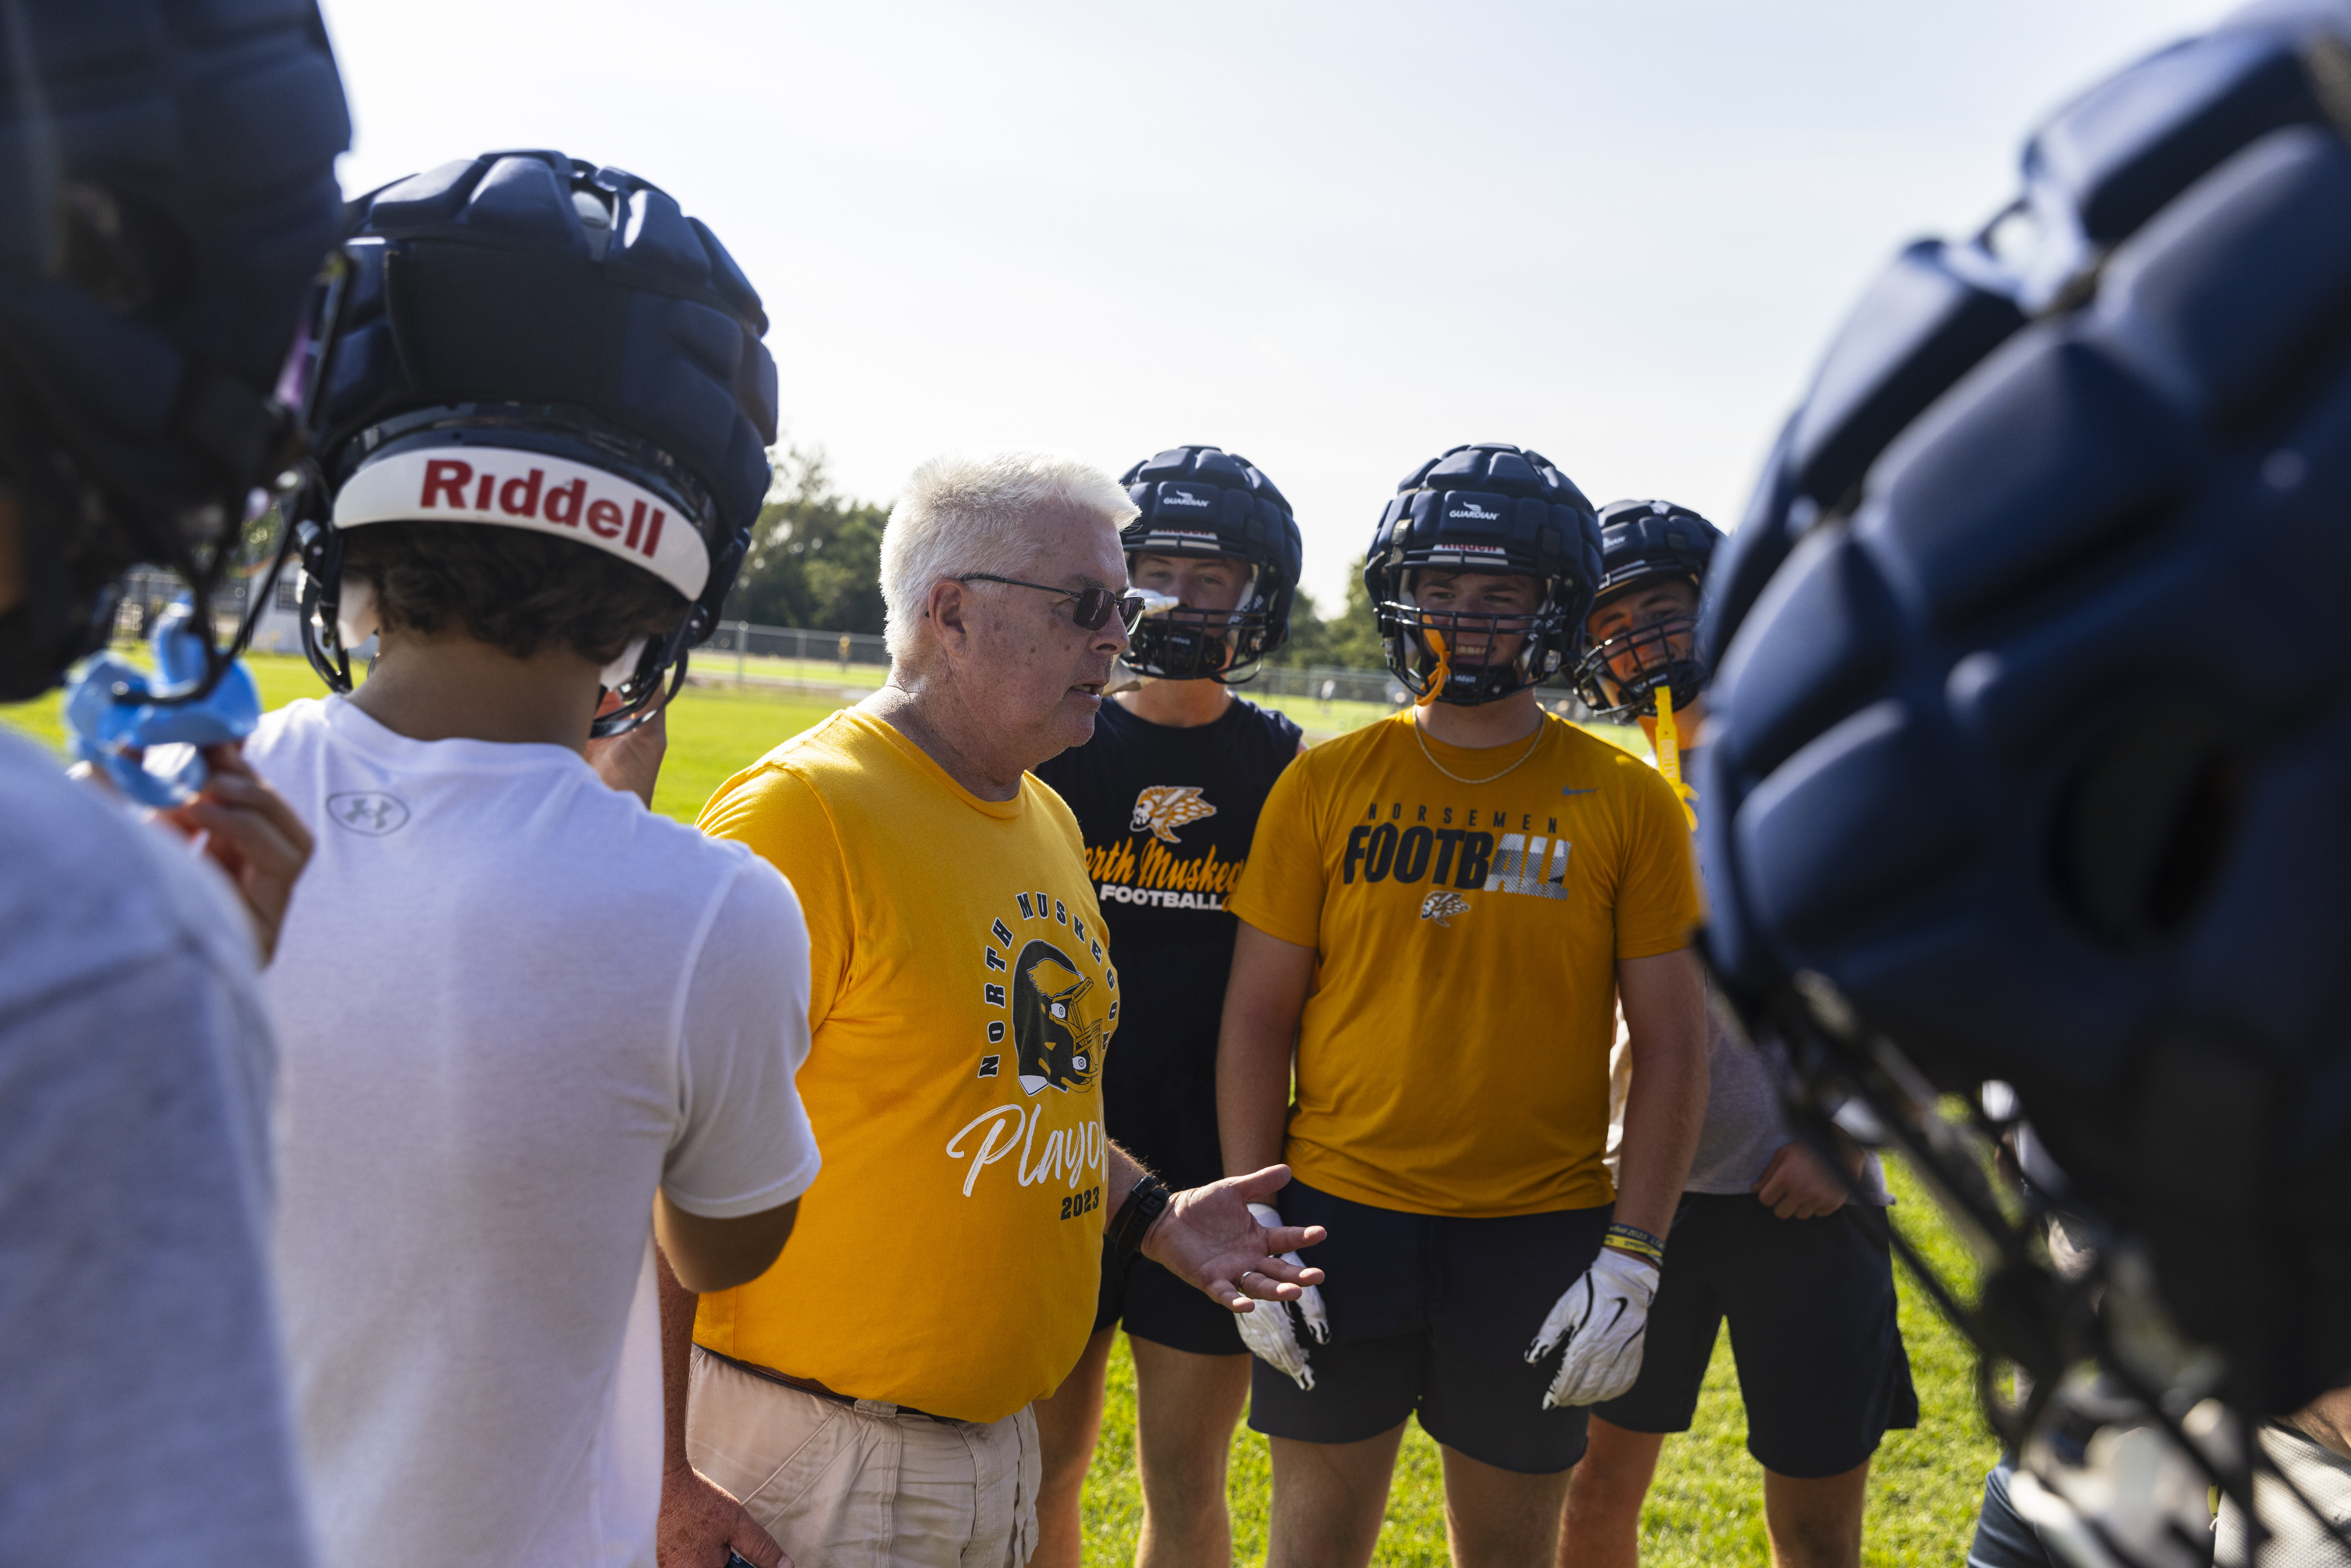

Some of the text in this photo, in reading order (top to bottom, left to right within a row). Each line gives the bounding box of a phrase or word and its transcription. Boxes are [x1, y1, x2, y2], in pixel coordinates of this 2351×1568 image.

[420, 458, 666, 559] Riddell
[1163, 497, 1209, 507] GUARDIAN
[1449, 509, 1498, 521] GUARDIAN
[1368, 802, 1557, 834] NORSEMEN
[1082, 836, 1136, 885] orth
[1343, 822, 1572, 900] FOOTBALL
[1099, 884, 1224, 911] FOOTBALL
[977, 916, 1014, 1079] NORTH
[1060, 1186, 1101, 1222] 2023
